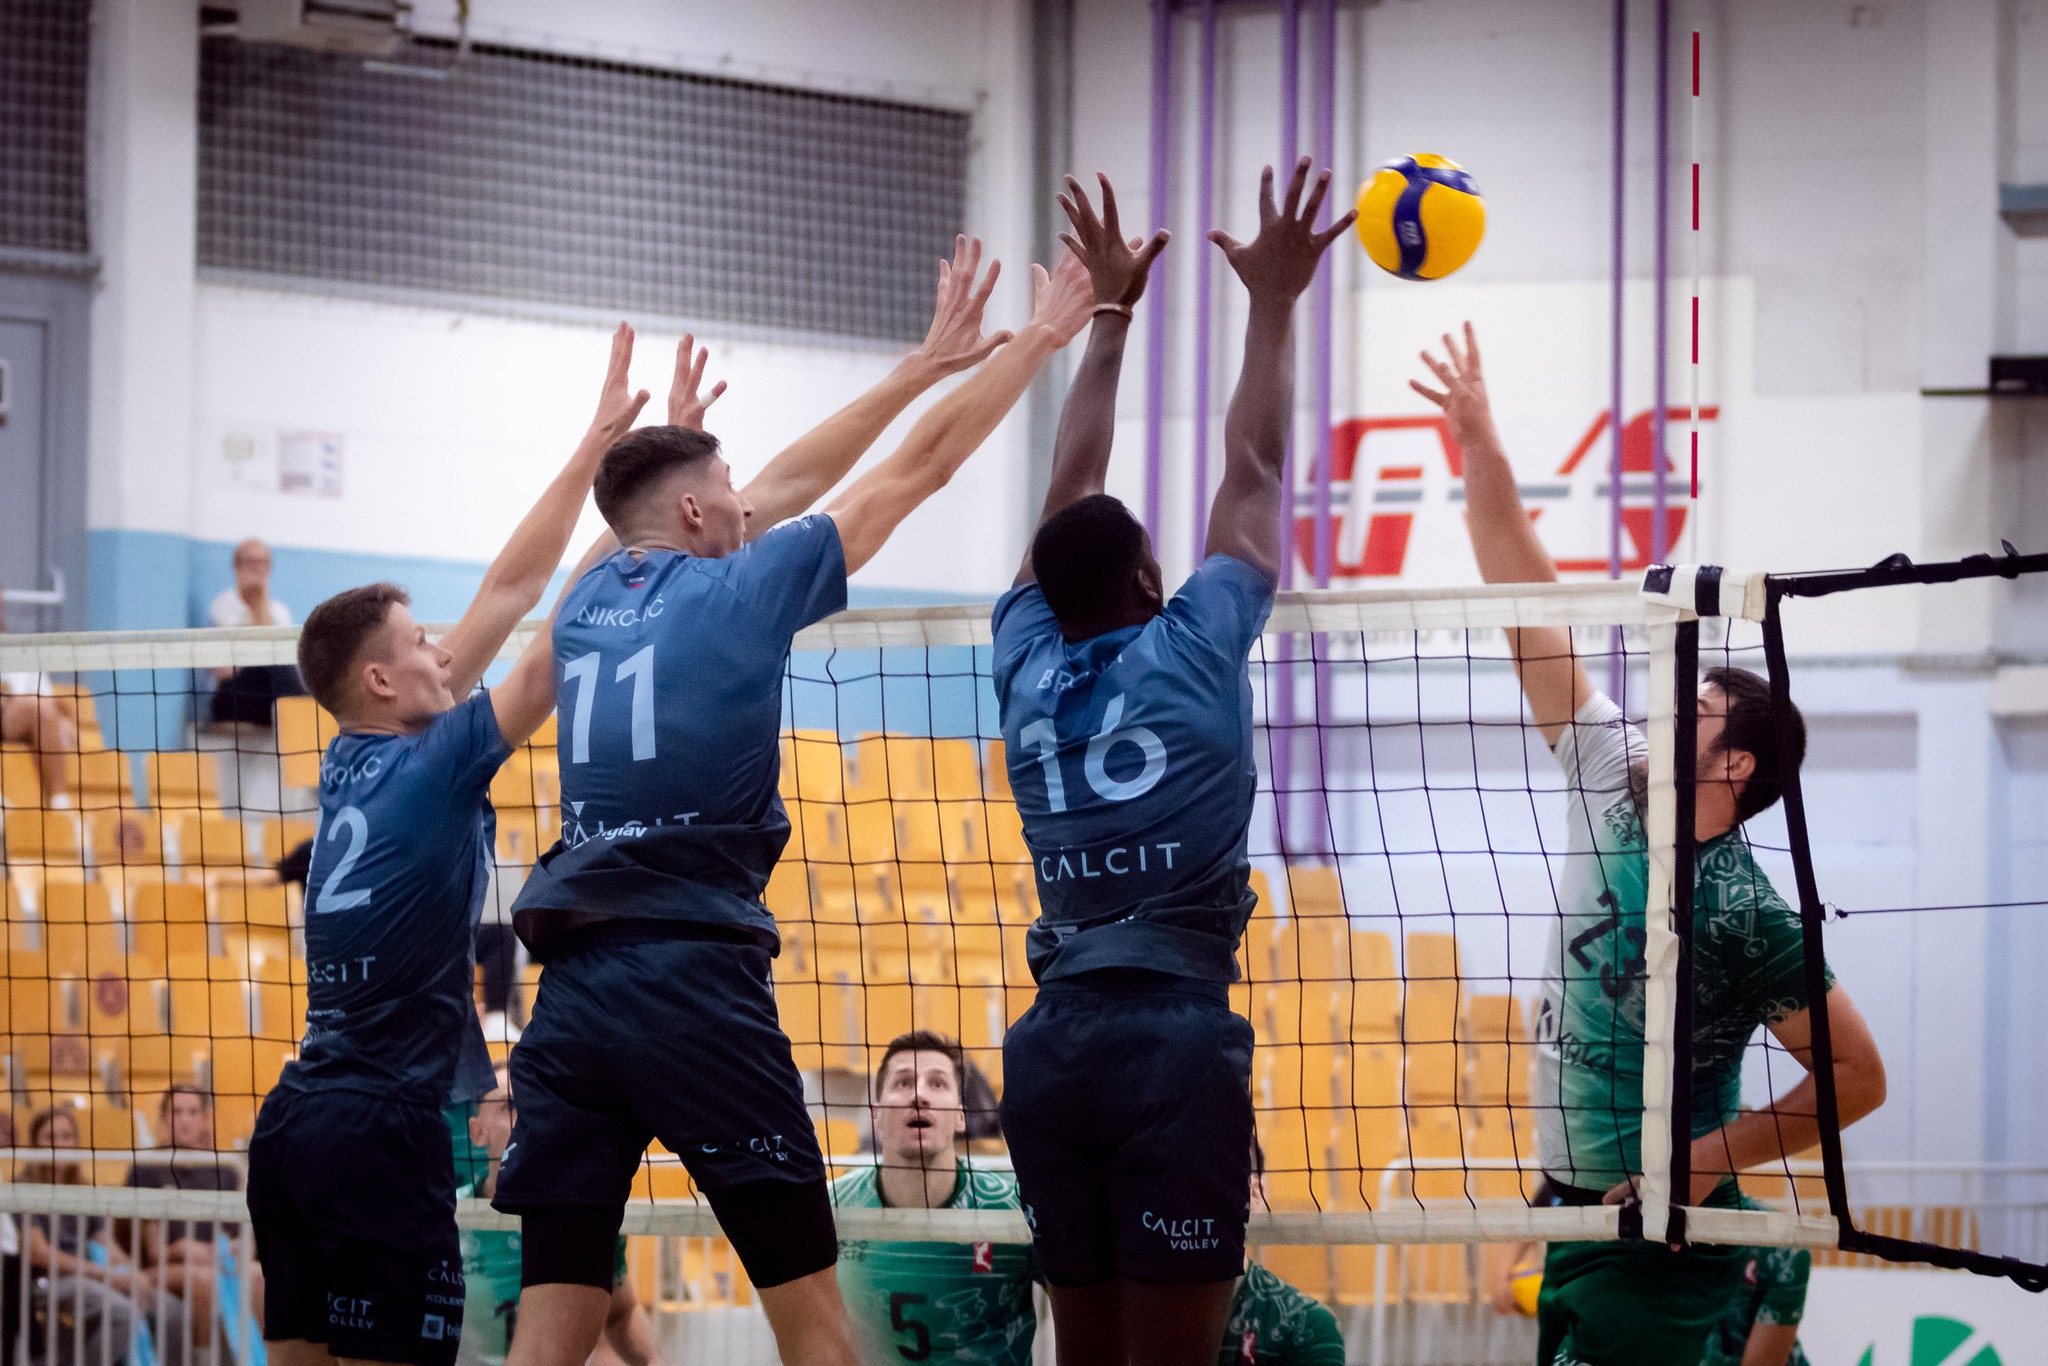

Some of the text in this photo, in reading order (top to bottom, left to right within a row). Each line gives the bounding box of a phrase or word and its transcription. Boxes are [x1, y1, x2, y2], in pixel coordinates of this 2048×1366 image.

[576, 593, 665, 627] NIKOIĆ
[563, 644, 657, 764] 11
[1020, 692, 1168, 813] 16
[1040, 842, 1181, 883] CALCIT
[1142, 1211, 1215, 1238] CALCIT
[1169, 1237, 1220, 1250] VOLLEY
[327, 1292, 373, 1317] CIT
[328, 1313, 375, 1331] OLLEY
[890, 1291, 932, 1362] 5
